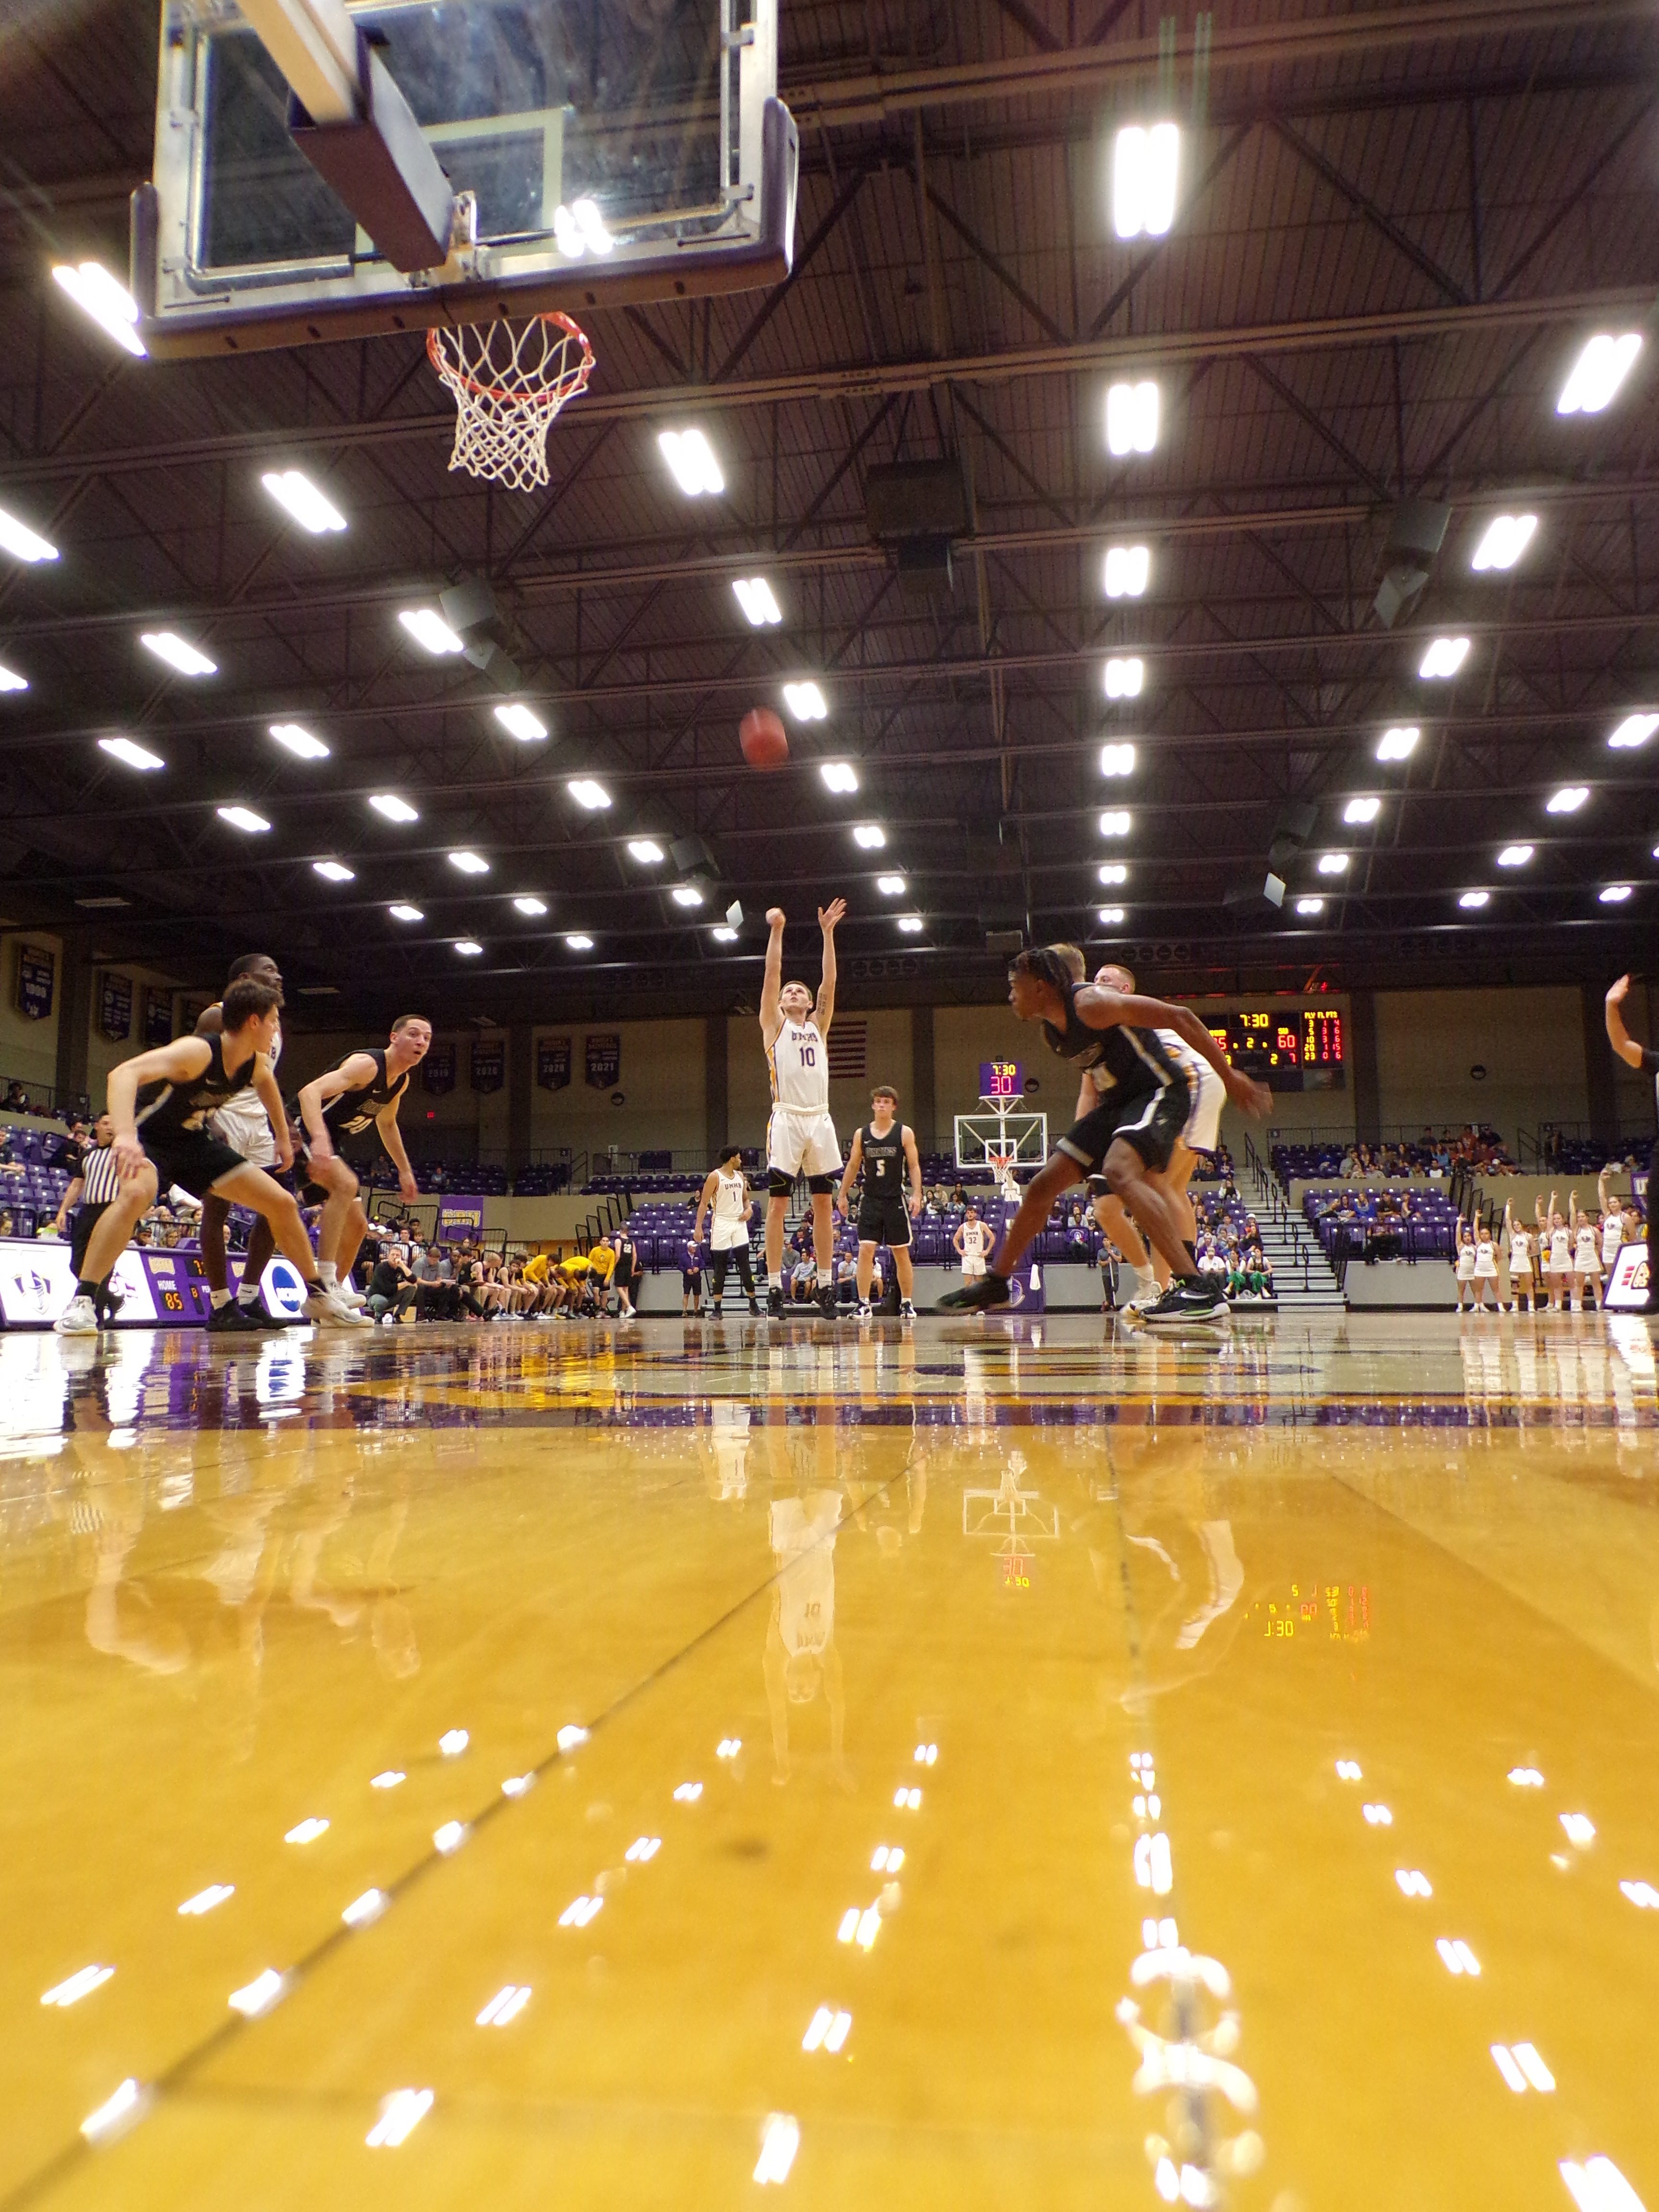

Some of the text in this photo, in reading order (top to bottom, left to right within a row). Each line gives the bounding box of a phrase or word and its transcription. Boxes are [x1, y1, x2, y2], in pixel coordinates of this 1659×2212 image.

[1240, 1014, 1269, 1027] 7:30
[1247, 1037, 1254, 1048] 2
[1278, 1035, 1295, 1048] 60
[800, 1047, 815, 1067] 10
[1270, 1053, 1296, 1064] 2 7
[591, 1063, 614, 1072] 2021
[993, 1064, 1016, 1076] 7:30
[991, 1076, 1011, 1094] 30
[876, 1160, 885, 1177] 5
[733, 1191, 736, 1202] 1
[624, 1243, 632, 1253] 22
[157, 1280, 178, 1290] HOME
